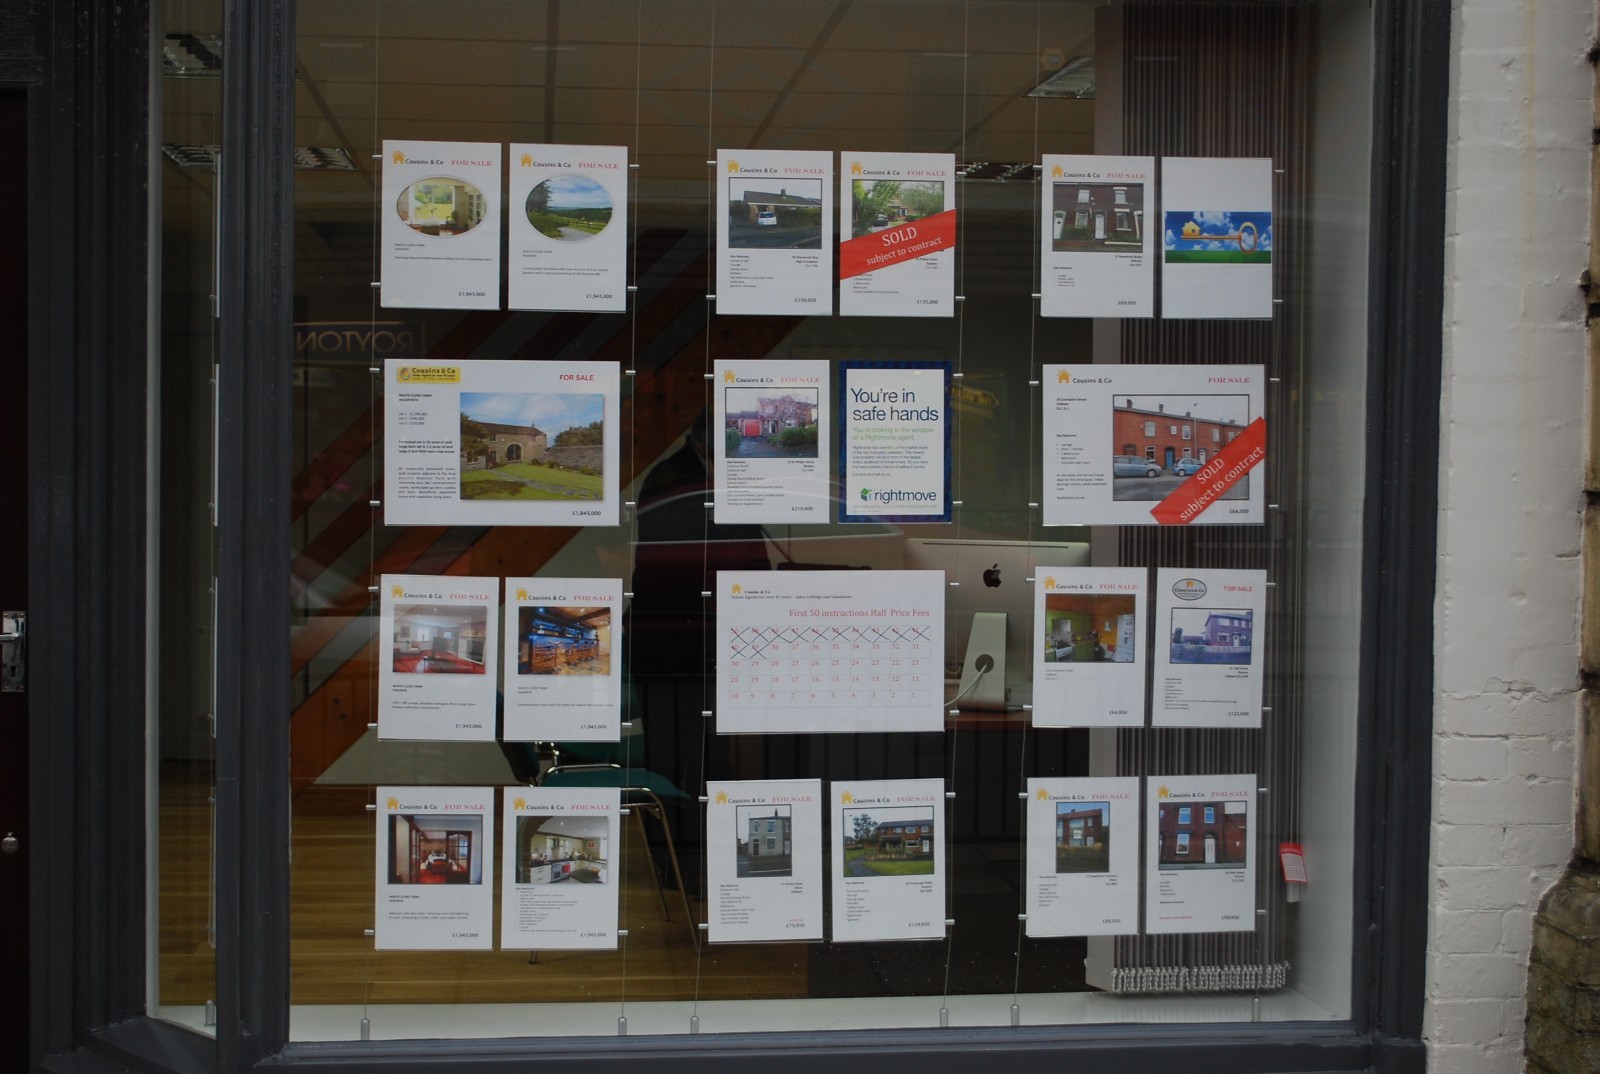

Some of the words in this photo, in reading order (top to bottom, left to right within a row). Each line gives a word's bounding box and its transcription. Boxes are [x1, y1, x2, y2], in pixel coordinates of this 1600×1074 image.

[882, 227, 917, 247] SOLD
[866, 250, 896, 266] subject
[897, 247, 906, 256] to
[908, 237, 942, 253] contract
[851, 388, 898, 404] You're
[903, 388, 915, 403] in
[853, 406, 886, 421] safe
[891, 406, 938, 421] hands
[1196, 458, 1224, 484] SOLD
[1180, 491, 1215, 522] subject
[1213, 482, 1225, 493] to
[1224, 446, 1263, 486] contract
[874, 489, 936, 504] rightmove
[789, 609, 808, 617] First
[809, 609, 820, 617] 50
[821, 609, 868, 617] instructions
[870, 609, 886, 617] Half
[890, 609, 911, 617] Price
[912, 609, 929, 617] Fees
